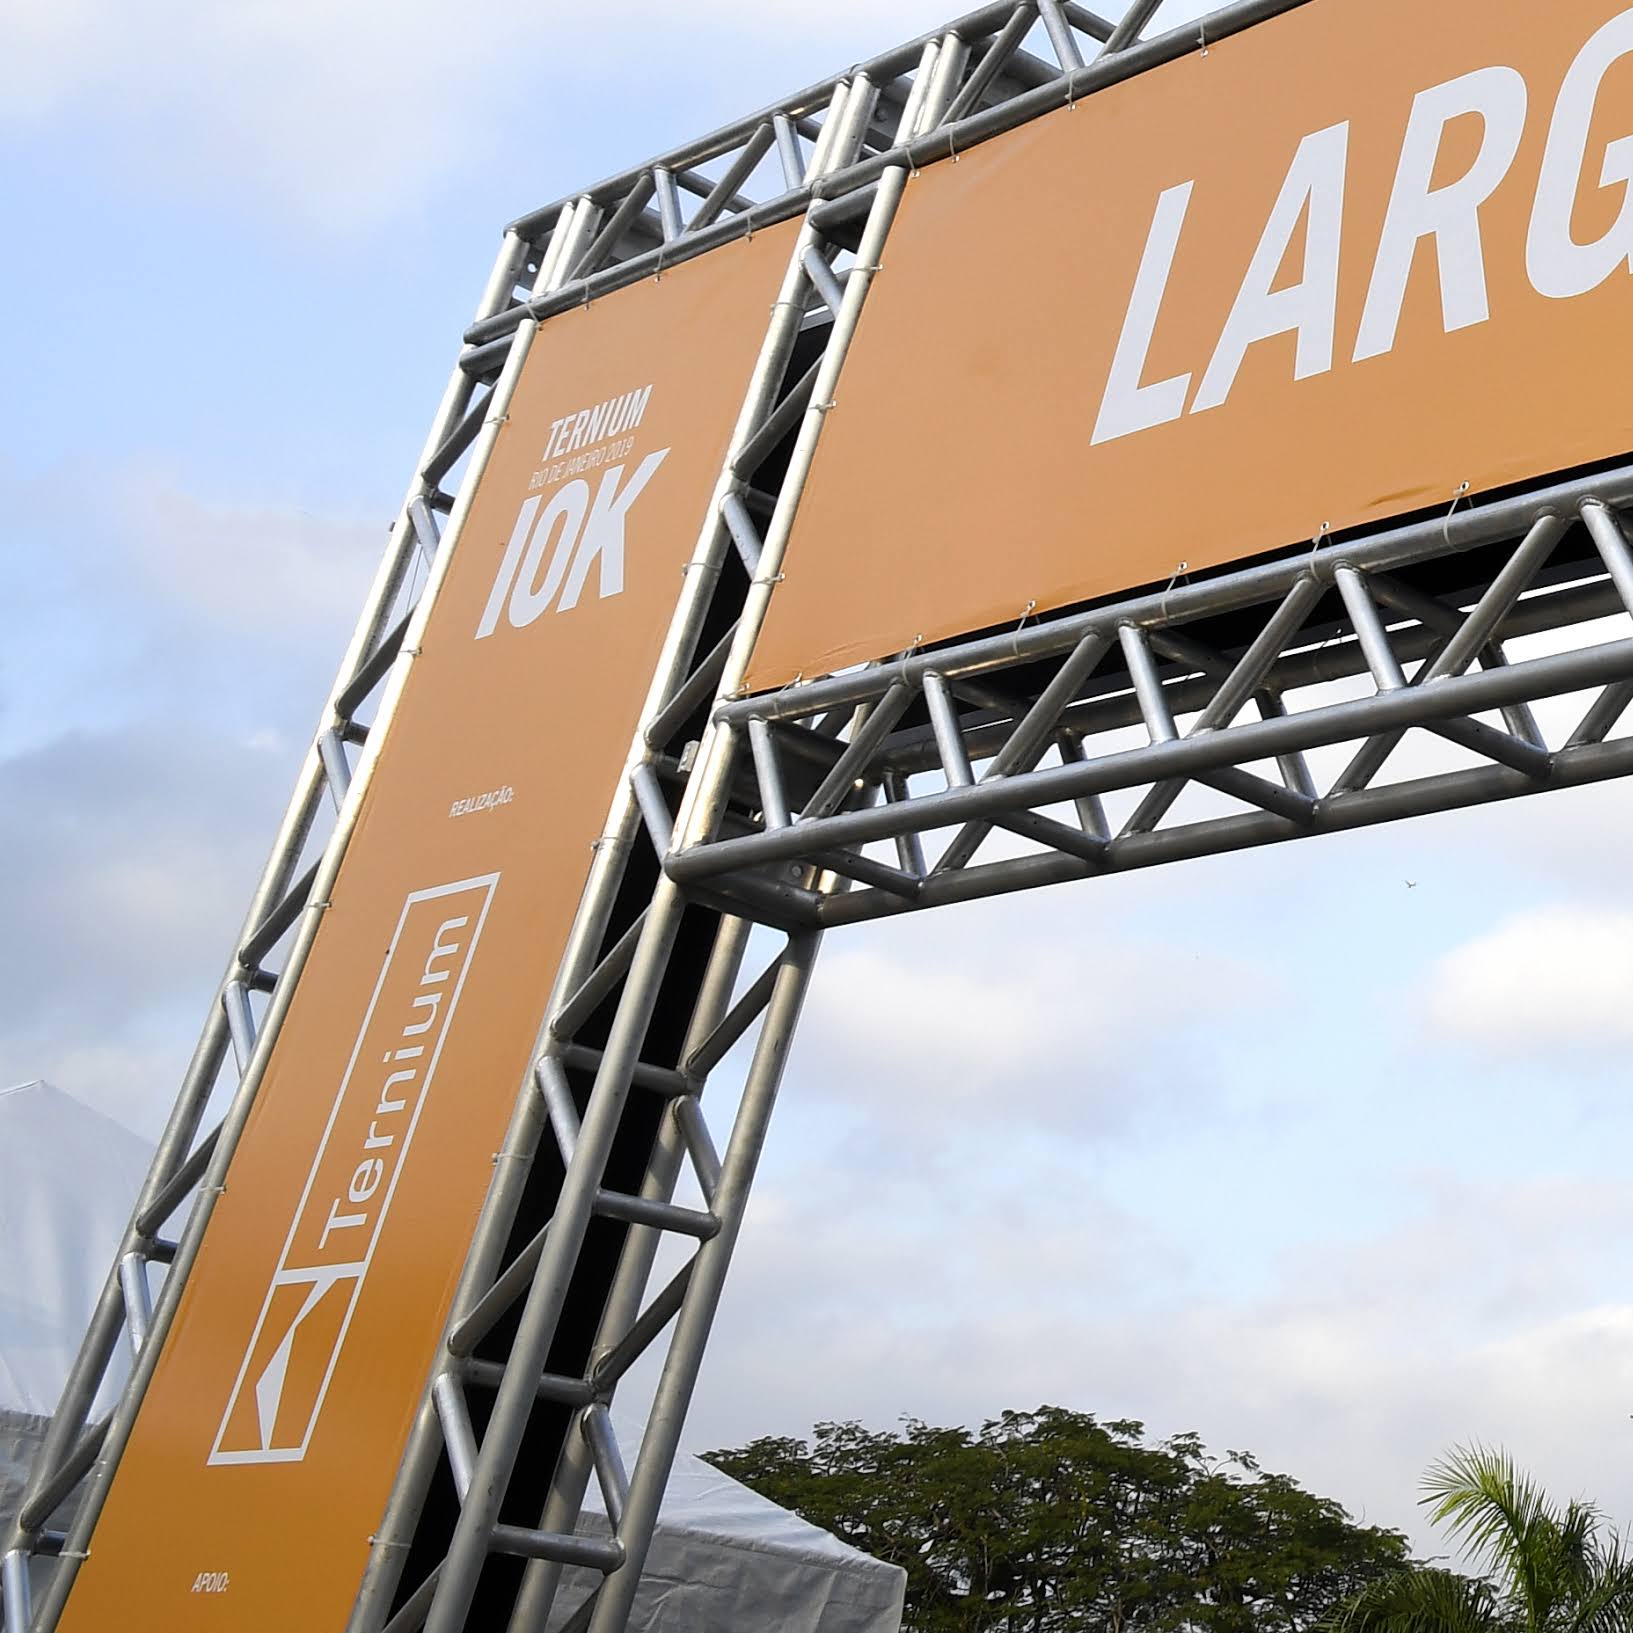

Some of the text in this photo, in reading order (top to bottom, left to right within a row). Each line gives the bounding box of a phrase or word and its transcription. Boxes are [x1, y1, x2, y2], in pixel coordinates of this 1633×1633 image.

[542, 384, 654, 462] TERNIUM
[603, 435, 635, 464] 2019
[319, 915, 469, 1250] Ternium
[190, 1571, 230, 1593] APOIO:
